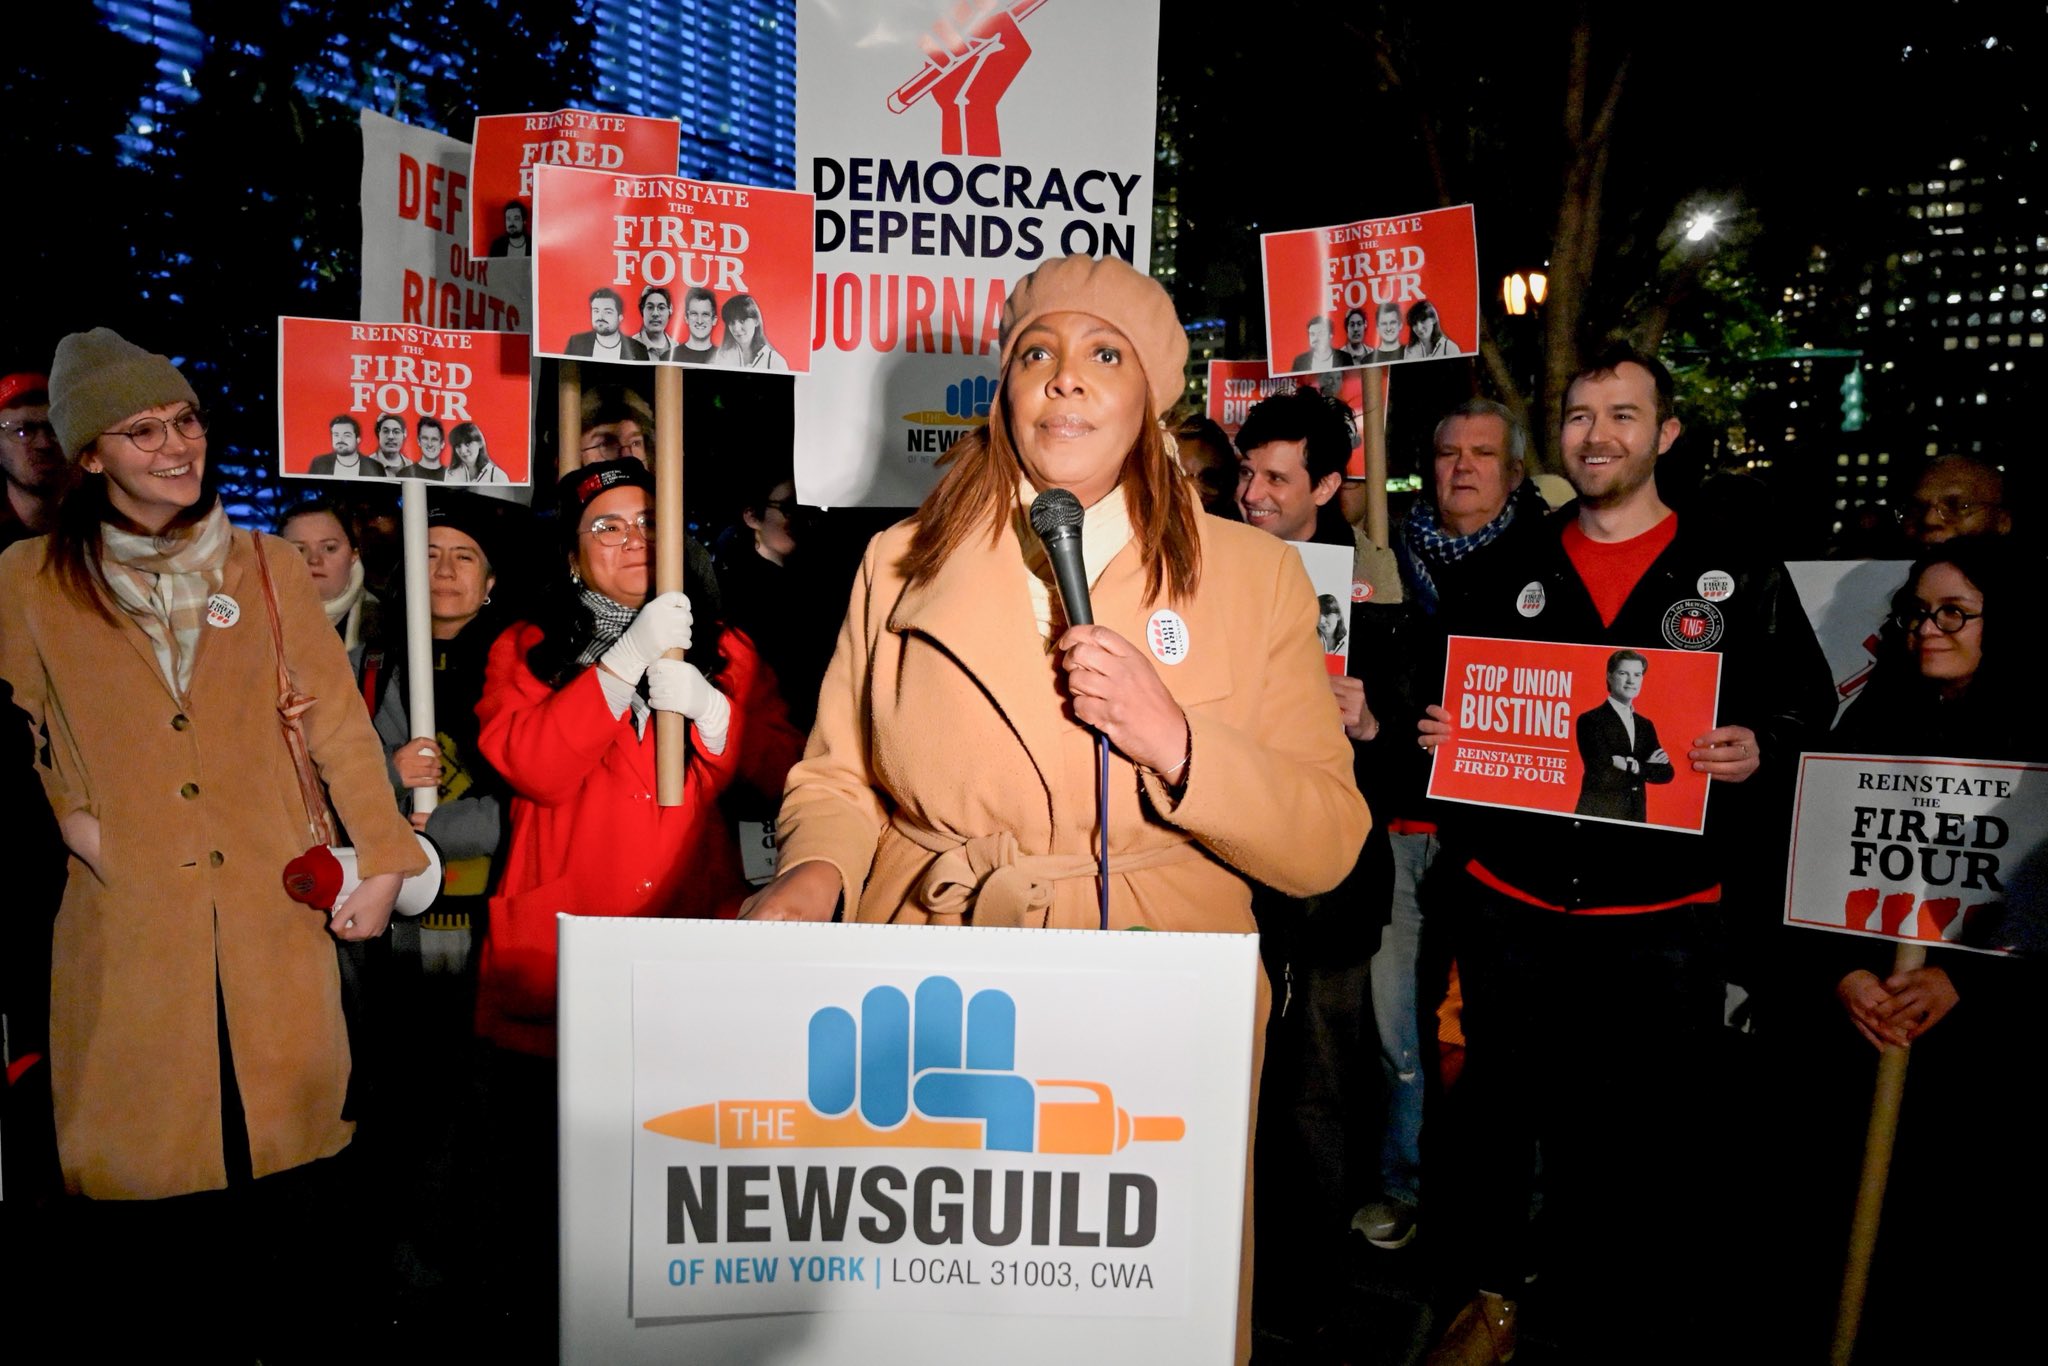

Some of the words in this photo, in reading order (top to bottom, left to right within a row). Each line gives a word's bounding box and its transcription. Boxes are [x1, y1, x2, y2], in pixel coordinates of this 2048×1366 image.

[525, 113, 625, 132] REINSTATE
[559, 129, 580, 138] THE
[520, 140, 624, 169] FIRED
[399, 153, 466, 235] DEF
[614, 179, 749, 208] REINSTATE
[813, 157, 1142, 216] DEMOCRACY
[668, 202, 694, 215] THE
[613, 215, 749, 254] FIRED
[815, 209, 1044, 260] DEPENDS
[1060, 219, 1135, 266] ON
[1325, 217, 1422, 244] REINSTATE
[1359, 240, 1379, 250] THE
[450, 243, 488, 287] OUR
[613, 250, 748, 292] FOUR
[1325, 246, 1425, 282] FIRED
[1326, 273, 1426, 312] FOUR
[812, 272, 1006, 356] JOURNA
[351, 325, 472, 349] REINSTATE
[401, 345, 424, 356] THE
[351, 354, 472, 389] FIRED
[1224, 378, 1256, 398] STOP
[350, 382, 472, 421] FOUR
[1682, 618, 1703, 637] TNG
[1464, 664, 1508, 692] STOP
[1513, 667, 1572, 698] UNION
[1460, 693, 1570, 739] BUSTING
[1453, 760, 1509, 778] FIRED
[1513, 766, 1566, 785] FOUR
[1457, 747, 1533, 766] REINSTATE
[1537, 756, 1567, 769] THE
[1857, 773, 2011, 798] REINSTATE
[1912, 797, 1940, 808] THE
[1851, 806, 2009, 849] FIRED
[1850, 841, 2004, 892] FOUR
[729, 1108, 795, 1140] THE
[667, 1165, 1158, 1248] NEWSGUILD
[668, 1258, 705, 1286] OF
[715, 1257, 778, 1284] NEW
[789, 1256, 865, 1283] YORK
[893, 1258, 981, 1285] LOCAL
[991, 1260, 1080, 1291] 31003,
[1091, 1262, 1154, 1289] CWA
